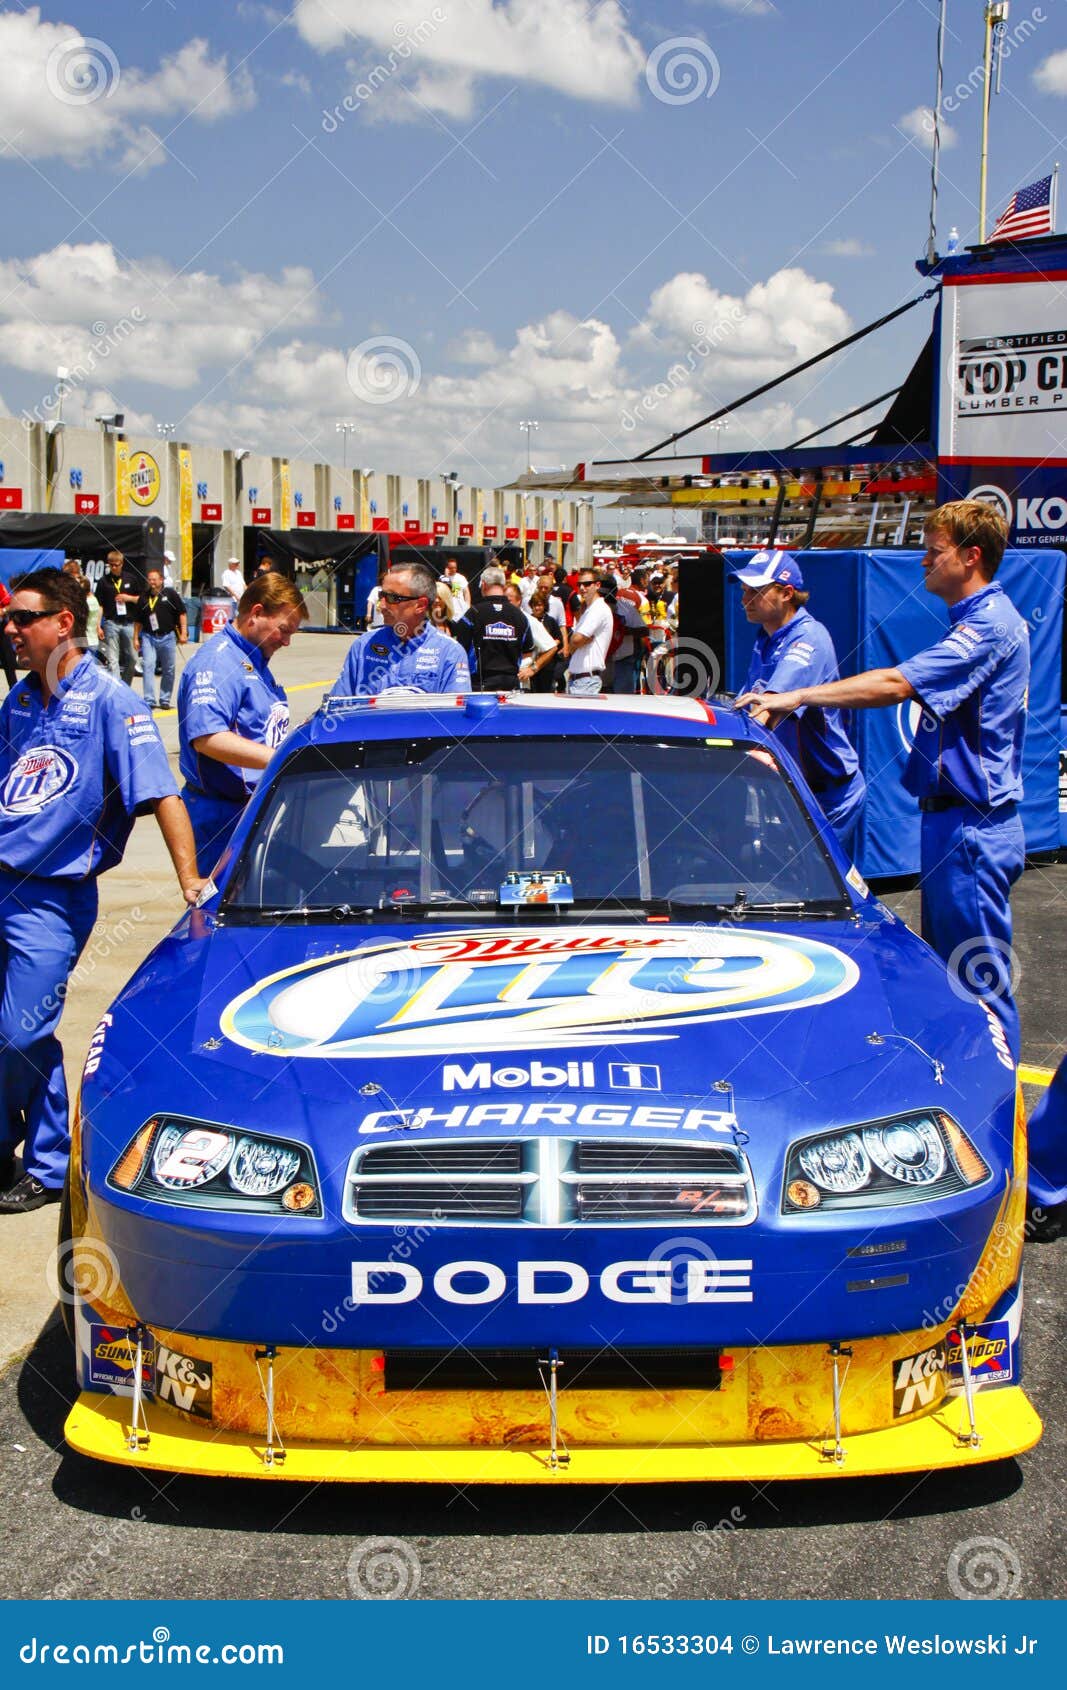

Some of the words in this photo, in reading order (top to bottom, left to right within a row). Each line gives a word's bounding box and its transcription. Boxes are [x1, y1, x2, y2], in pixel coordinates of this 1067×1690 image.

[987, 333, 1066, 349] CERTIFIED
[959, 359, 1026, 396] TOP
[958, 395, 1039, 410] LUMBER
[1016, 536, 1037, 545] NEXT
[1038, 535, 1067, 544] GENER
[410, 937, 688, 963] Miller
[317, 950, 770, 1047] Lite
[442, 1061, 595, 1091] Mobil
[357, 1102, 735, 1134] CHARGER
[156, 1128, 230, 1181] 2
[351, 1259, 753, 1305] DODGE
